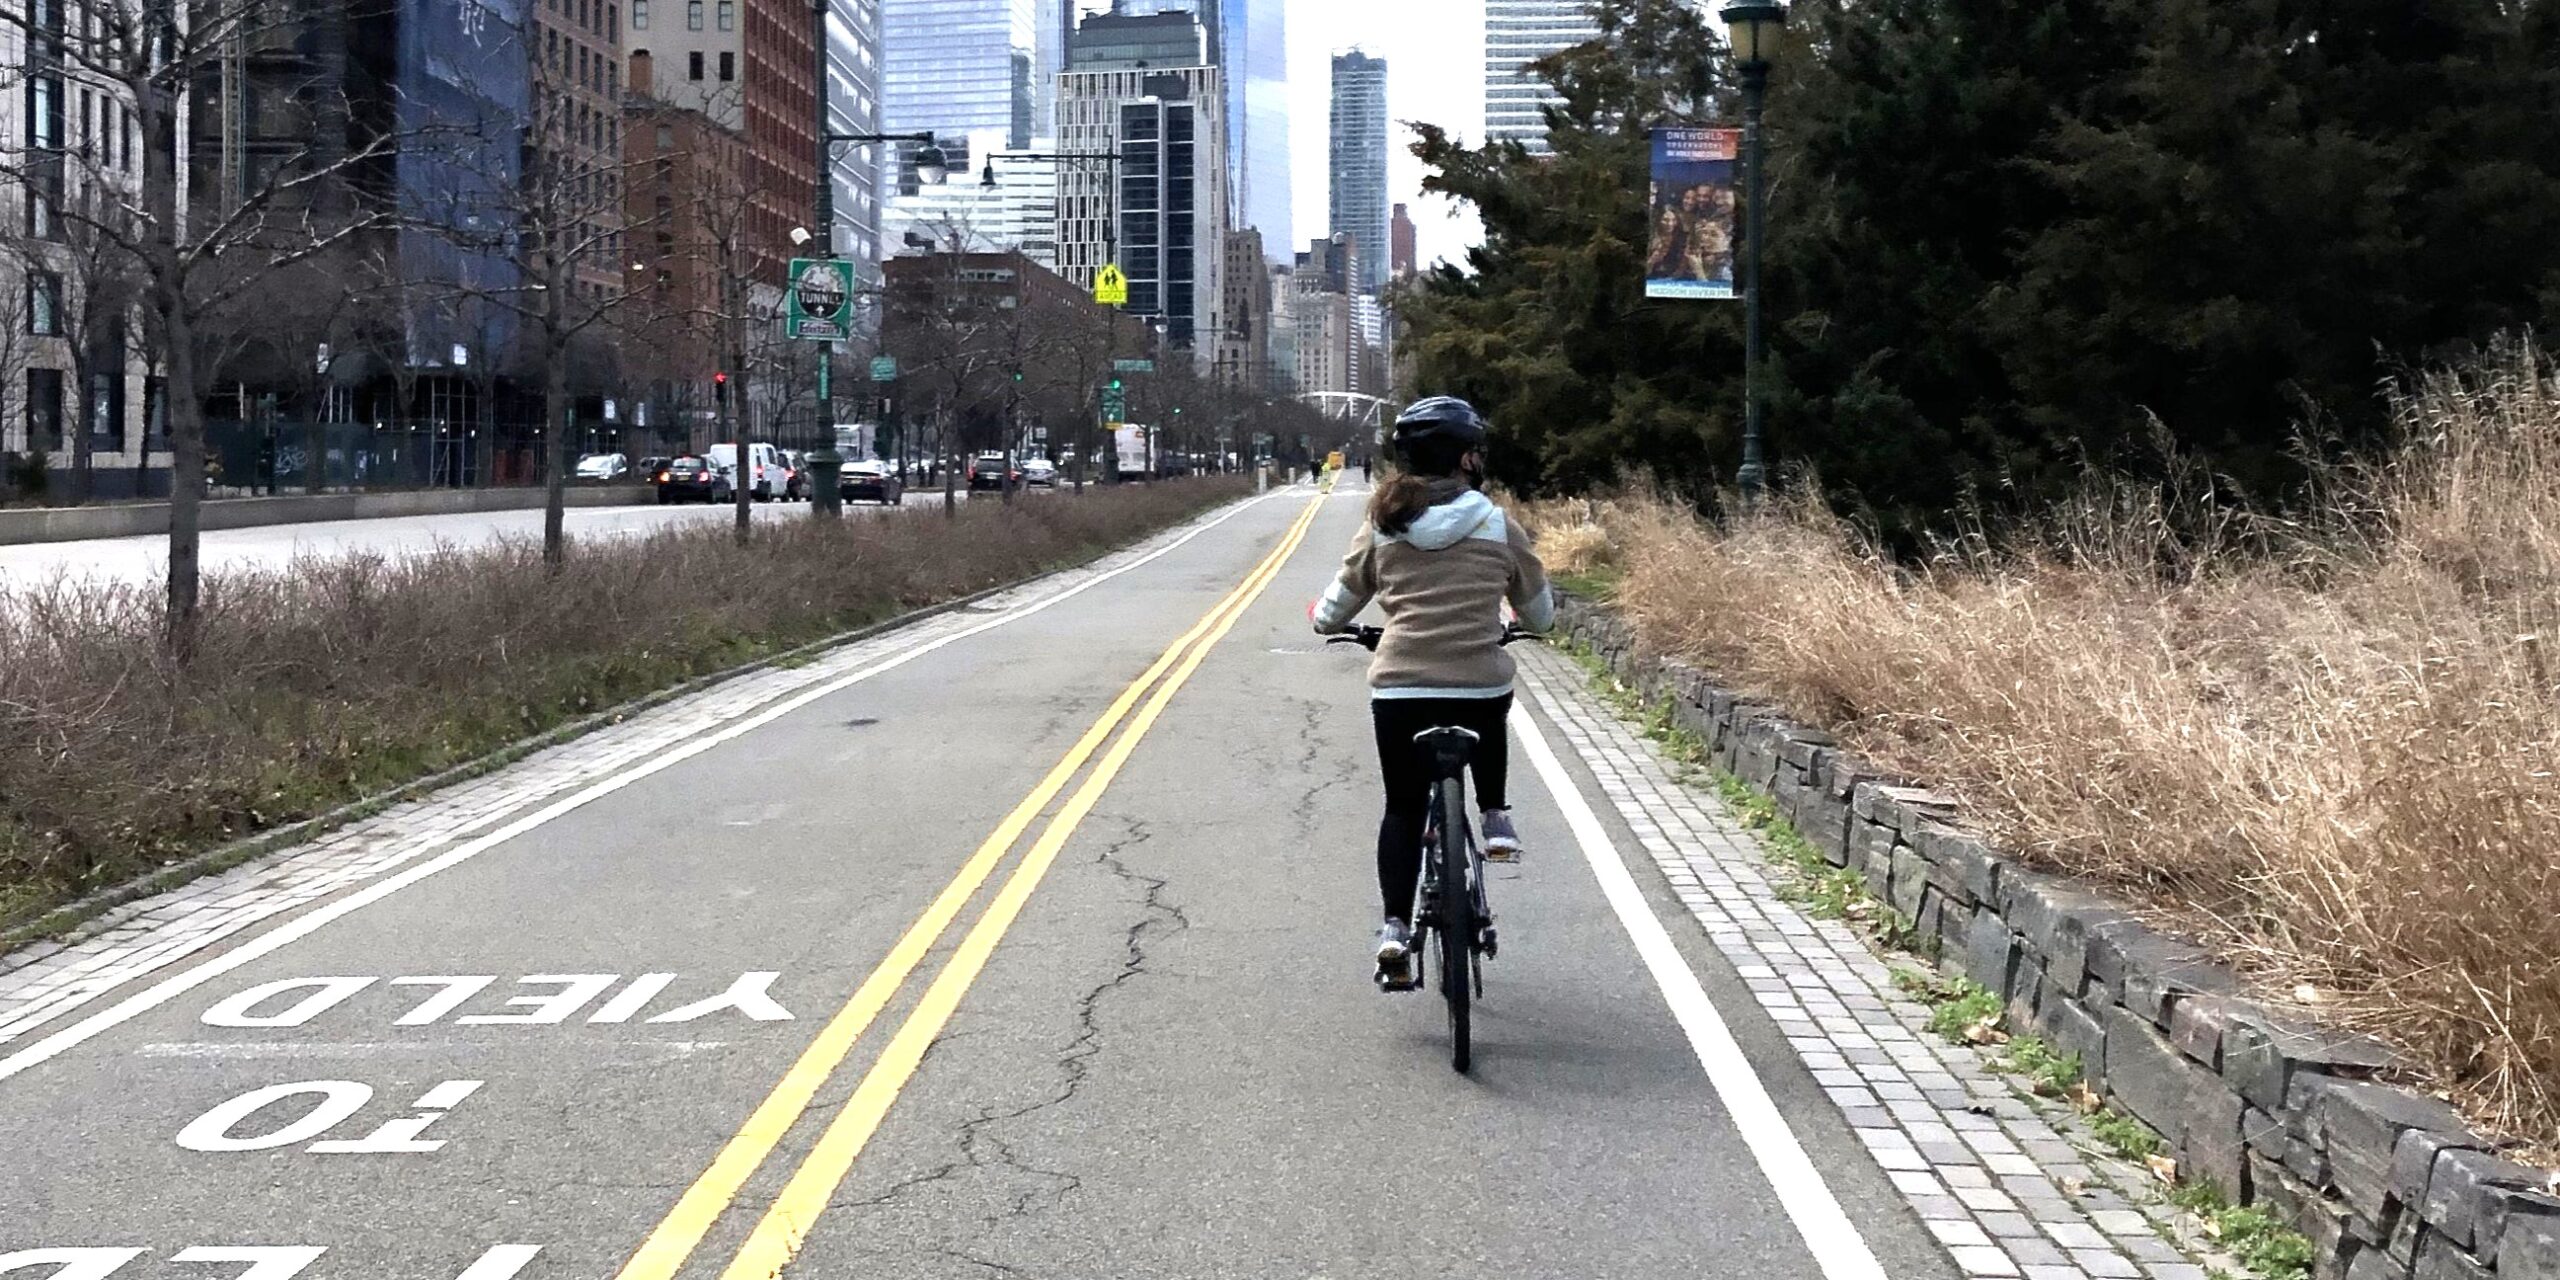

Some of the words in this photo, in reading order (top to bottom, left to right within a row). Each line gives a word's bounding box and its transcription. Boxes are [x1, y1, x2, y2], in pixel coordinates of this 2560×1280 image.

[1666, 131, 1687, 140] ONE
[1688, 131, 1724, 141] WORLD
[801, 292, 842, 304] TUNNEL
[201, 970, 796, 1027] YIELD
[175, 1079, 485, 1153] TO
